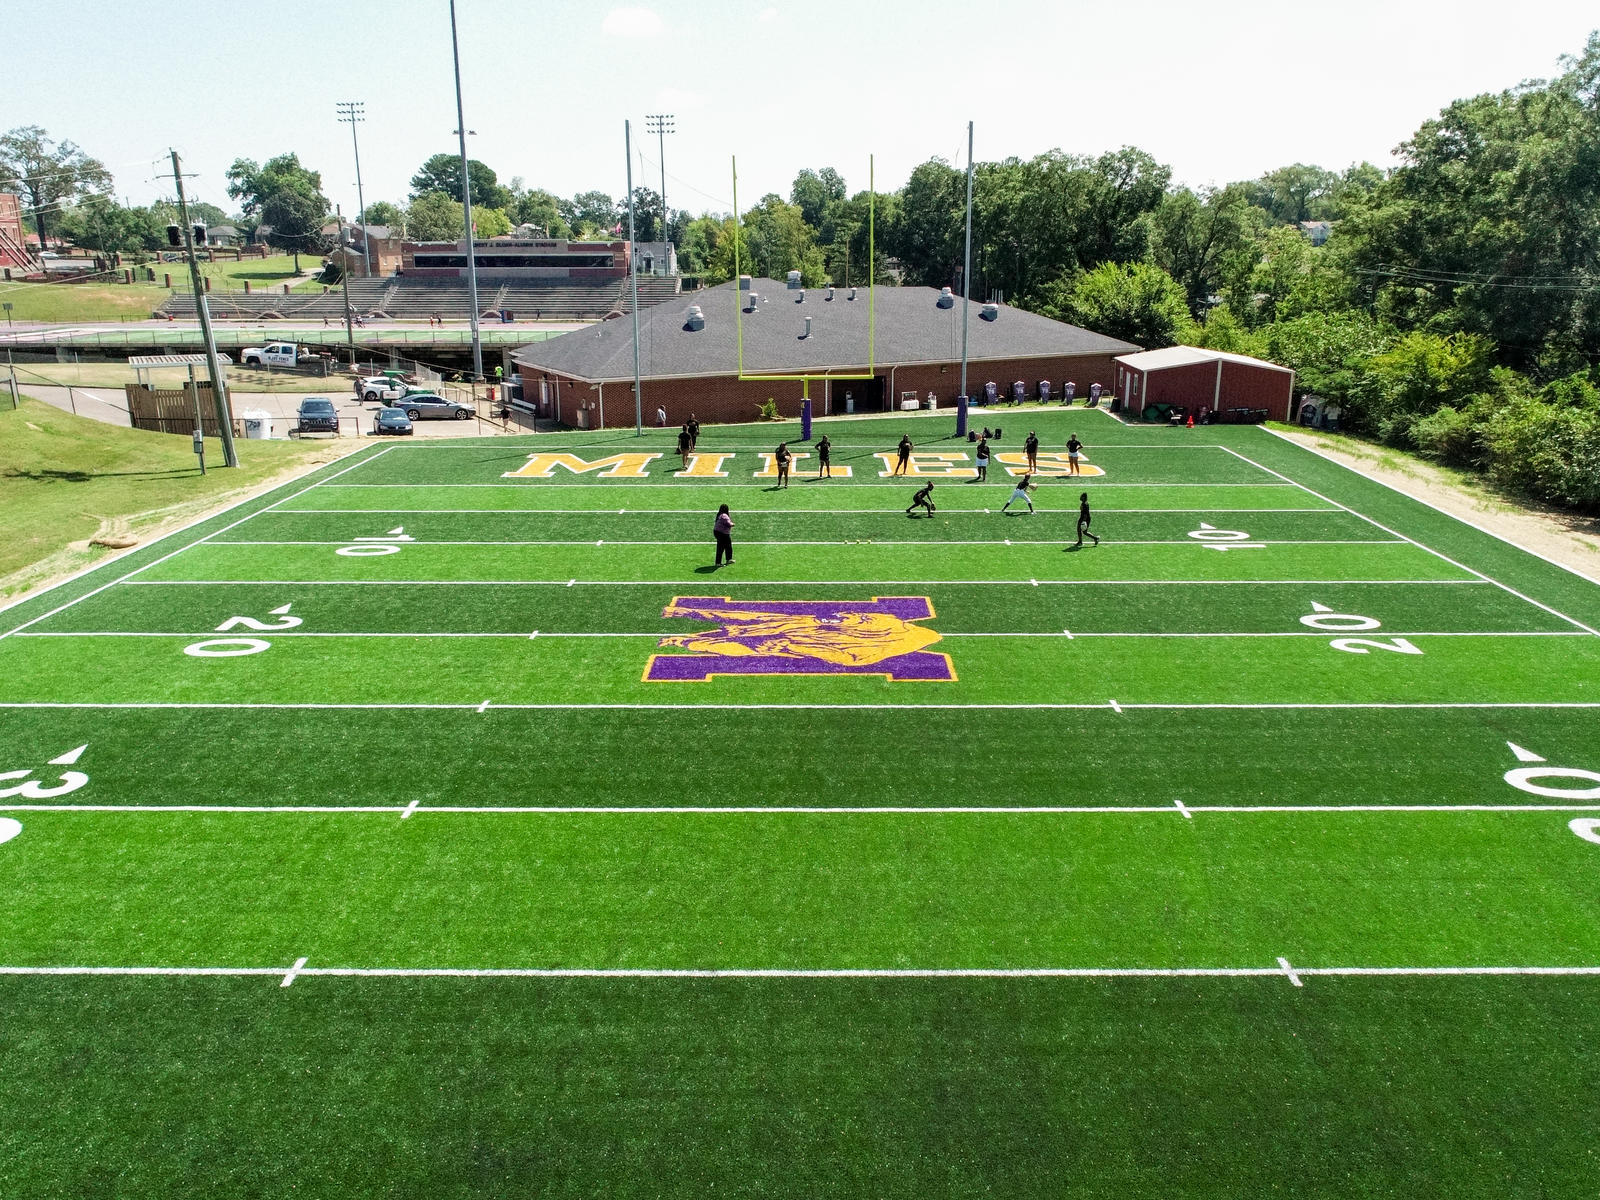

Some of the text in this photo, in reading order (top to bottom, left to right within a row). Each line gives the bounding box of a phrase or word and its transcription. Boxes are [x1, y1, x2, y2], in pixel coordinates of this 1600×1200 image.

[500, 452, 1106, 477] MILES
[335, 534, 416, 556] 10
[1187, 530, 1267, 551] 10
[184, 616, 303, 657] 20
[1300, 613, 1424, 654] 20
[1504, 767, 1600, 844] 0
